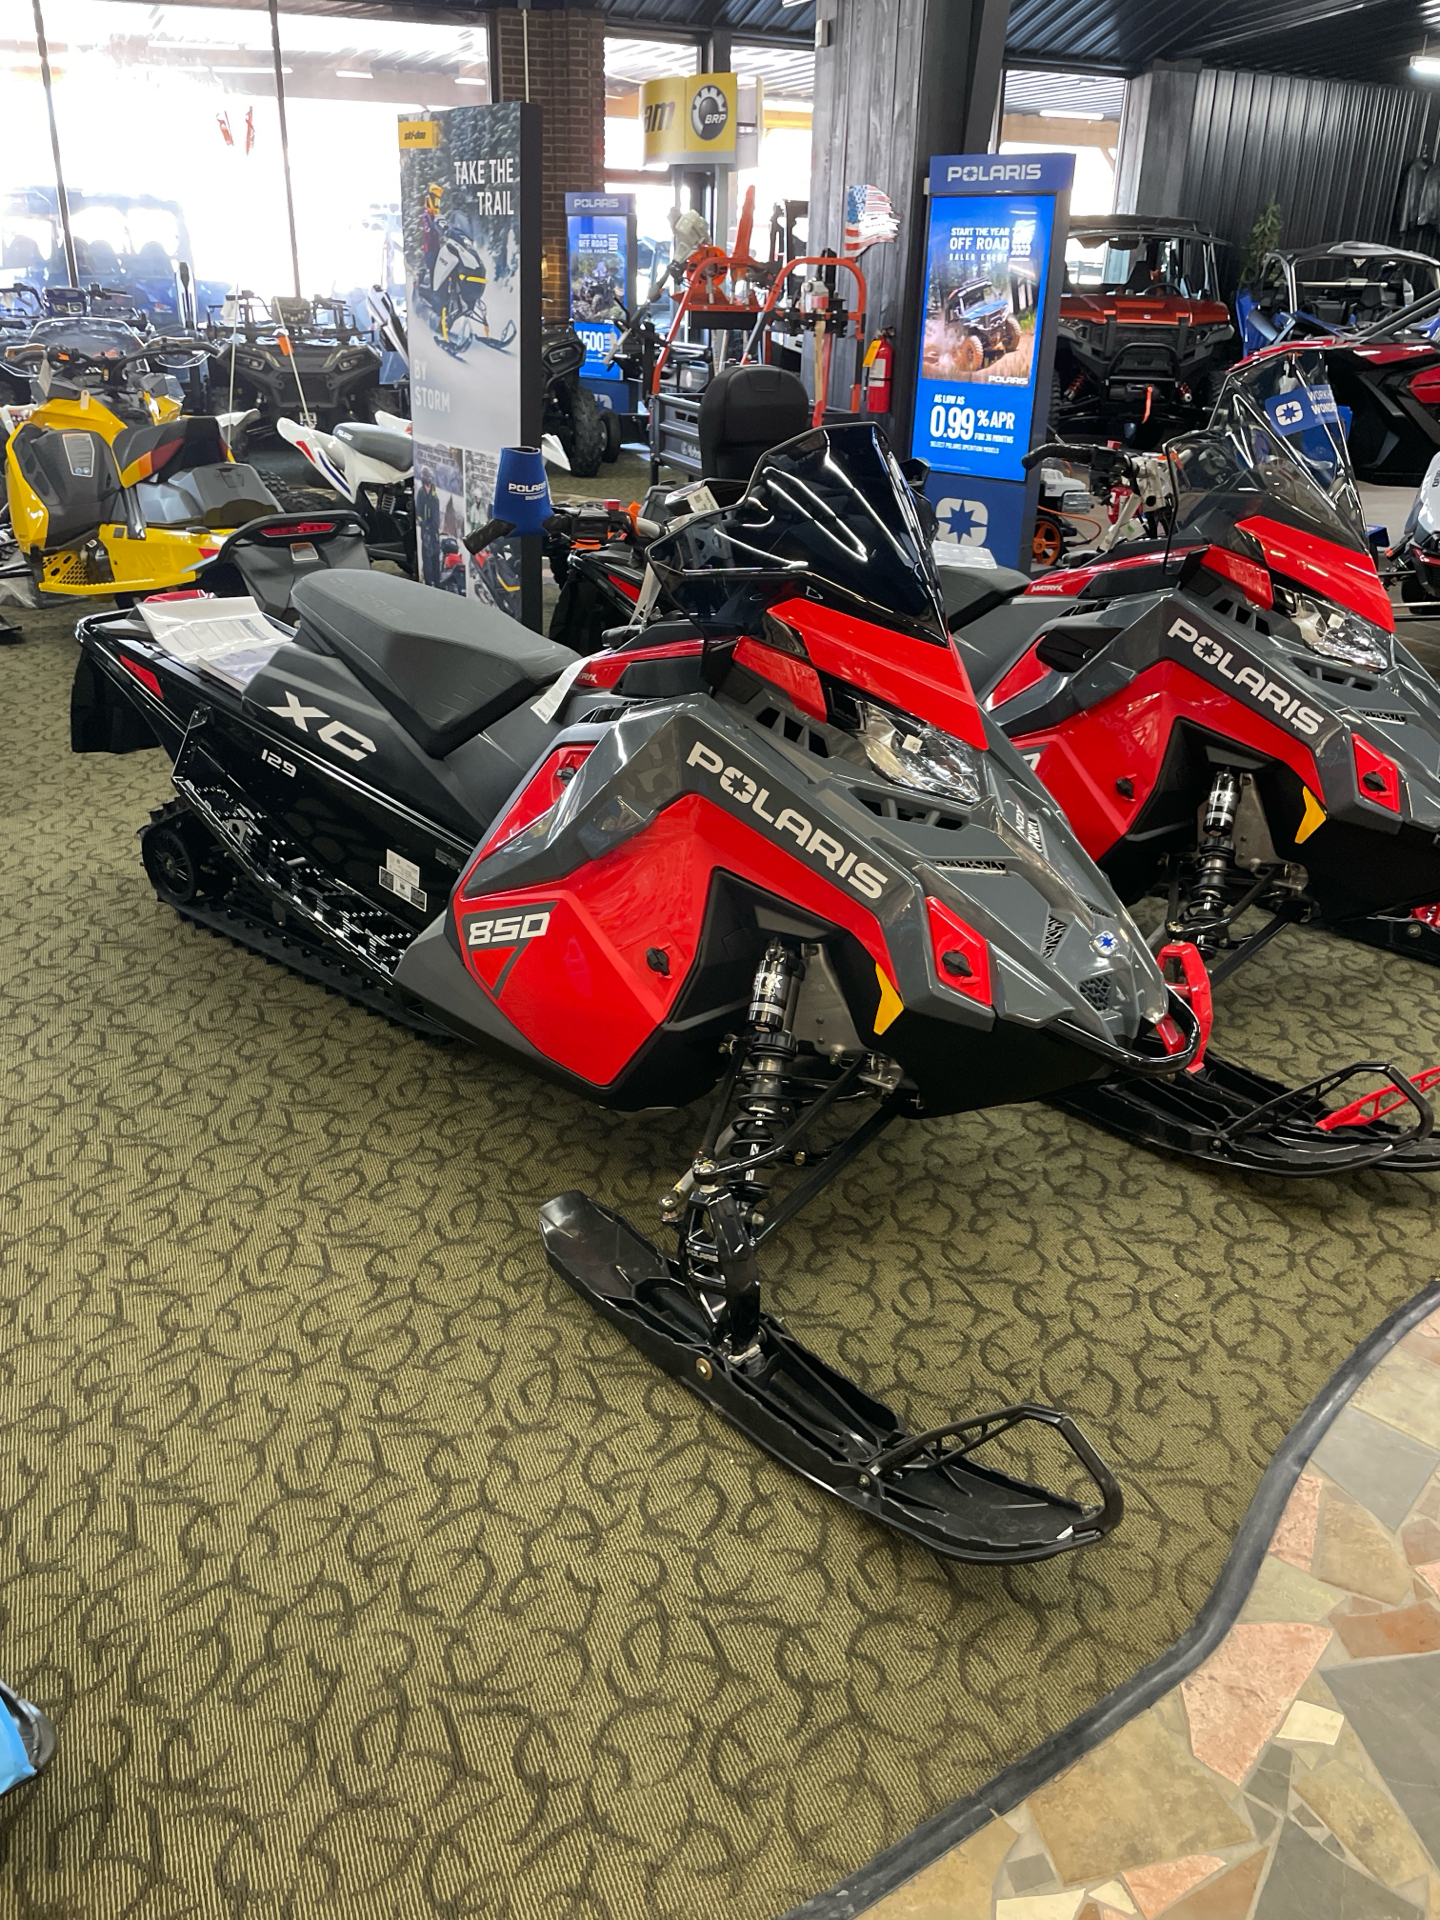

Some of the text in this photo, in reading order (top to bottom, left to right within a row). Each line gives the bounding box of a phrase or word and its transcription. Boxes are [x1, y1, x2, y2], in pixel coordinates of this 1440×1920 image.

[704, 113, 727, 124] BRP
[453, 158, 514, 186] TAKE THE
[947, 163, 1042, 182] POLARIS
[476, 190, 515, 216] TRAIL
[574, 198, 619, 209] POLARIS
[951, 227, 1010, 236] START THE YEAR
[949, 237, 1010, 250] OFF ROAD
[414, 358, 427, 381] BY
[988, 375, 1029, 385] POLARIS
[414, 385, 451, 414] STORM
[933, 394, 965, 405] AS LOW AS
[990, 410, 1016, 430] APR
[1167, 617, 1325, 735] POLARIS
[267, 690, 377, 762] XC
[261, 748, 297, 778] 129
[686, 740, 889, 900] POLARIS
[468, 911, 551, 946] 850
